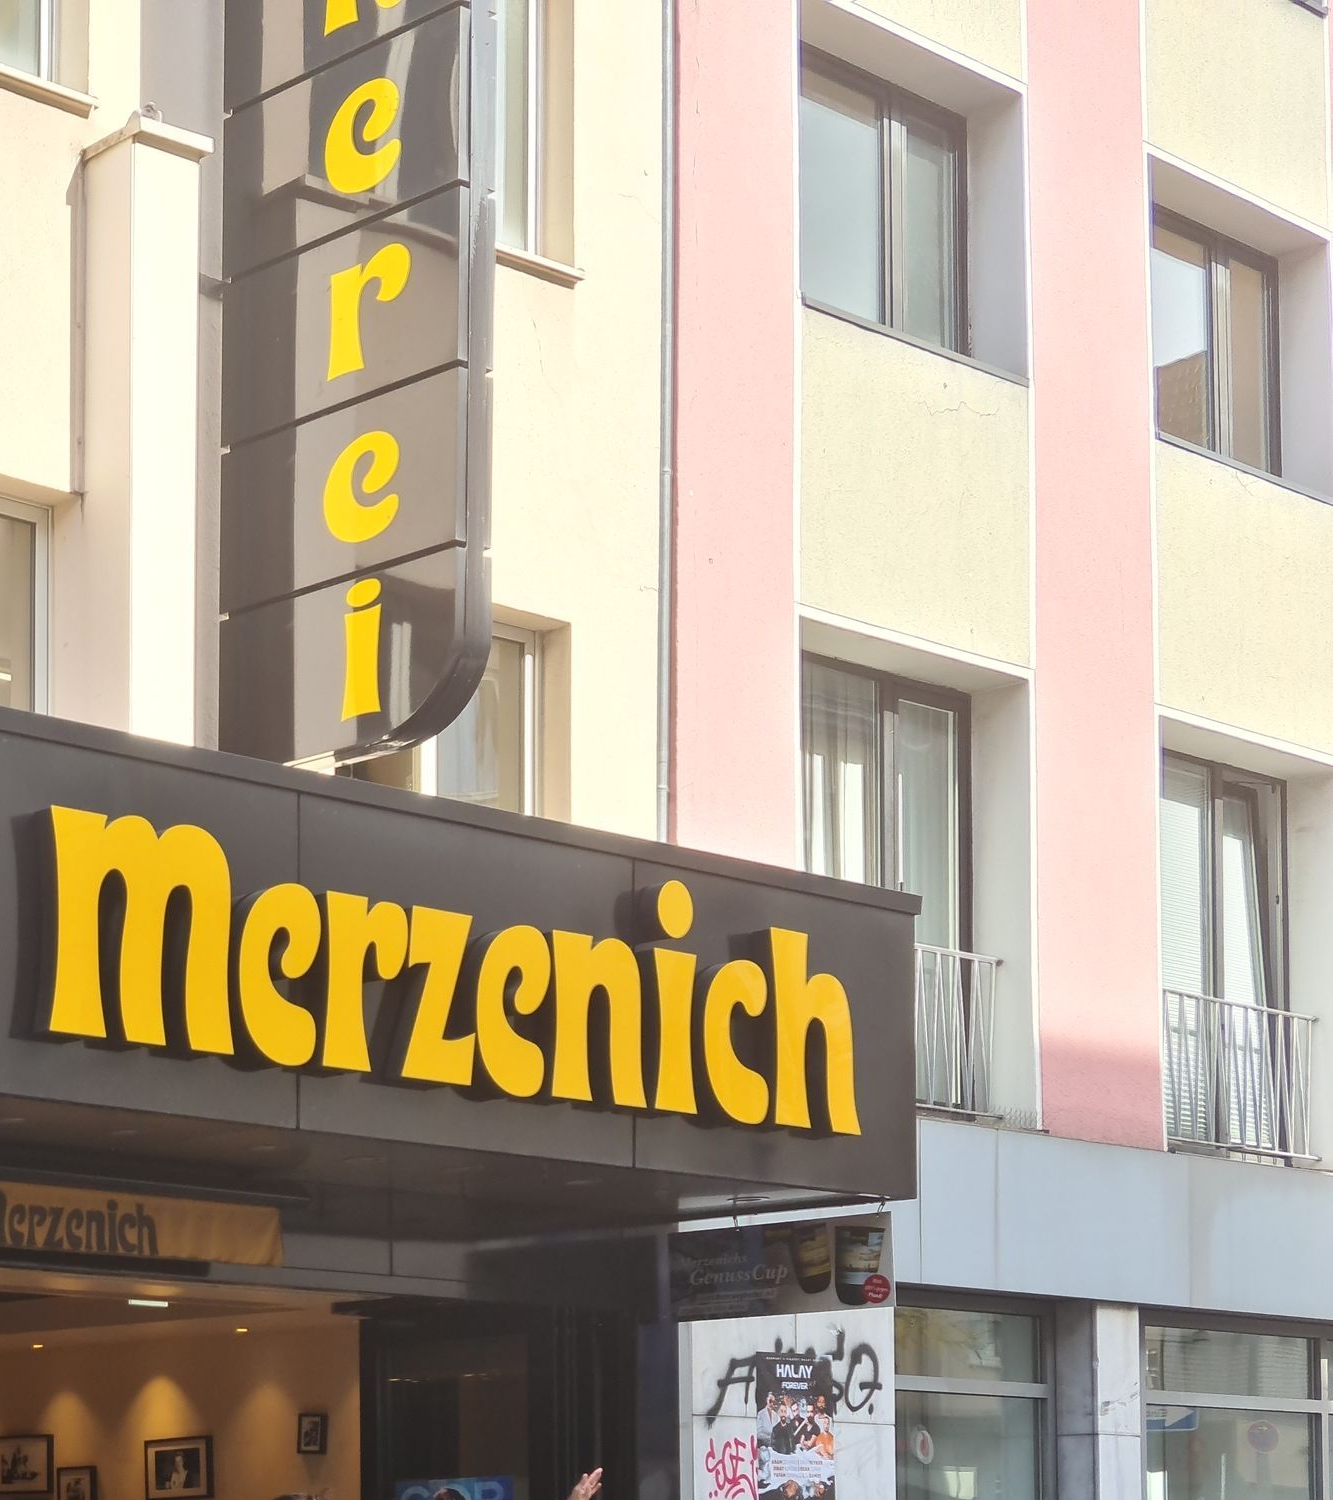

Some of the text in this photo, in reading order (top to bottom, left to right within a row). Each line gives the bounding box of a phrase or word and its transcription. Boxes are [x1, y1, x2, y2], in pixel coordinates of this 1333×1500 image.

[323, 0, 412, 722] erei
[753, 1262, 790, 1285] Cup
[776, 1363, 813, 1379] HALAY
[781, 1380, 809, 1391] FOREVER
